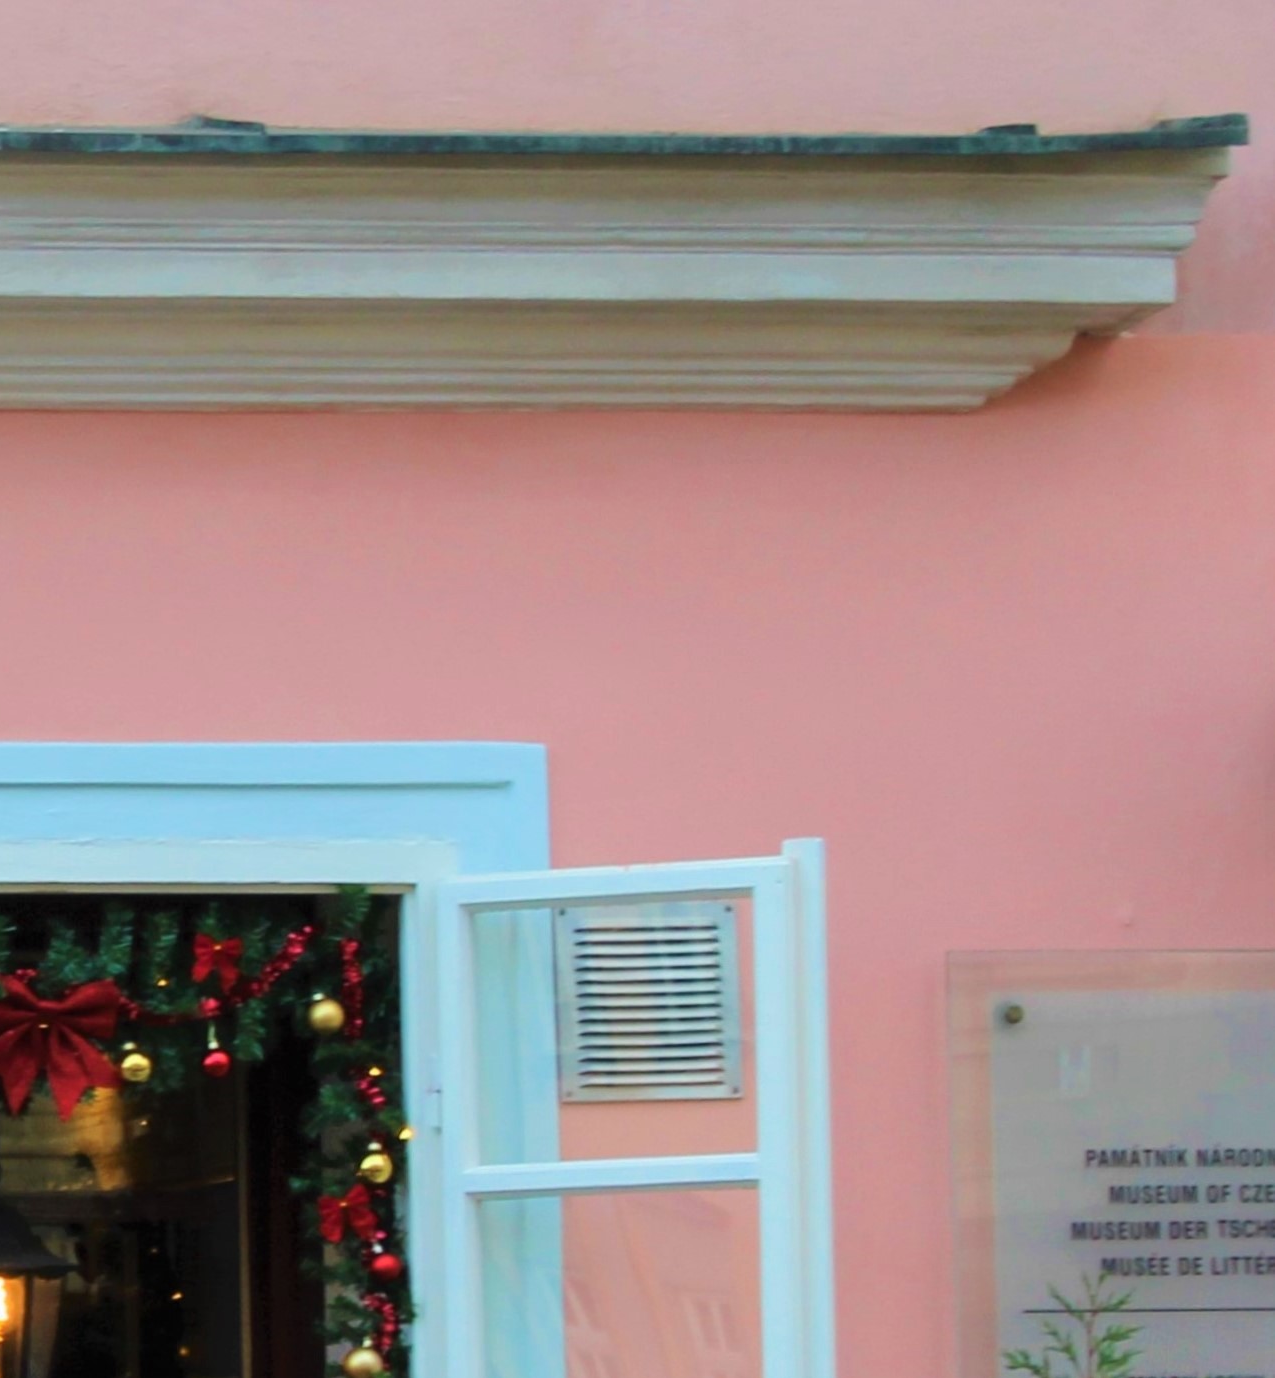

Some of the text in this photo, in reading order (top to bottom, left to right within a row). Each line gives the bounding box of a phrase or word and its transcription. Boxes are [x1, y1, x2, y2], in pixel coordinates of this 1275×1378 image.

[1085, 1144, 1187, 1168] PAMÁTNÍK
[1109, 1185, 1275, 1204] MUSEUM OF CZE
[1070, 1221, 1161, 1241] MUSEUM
[1168, 1221, 1208, 1240] DER
[1177, 1256, 1203, 1276] DE
